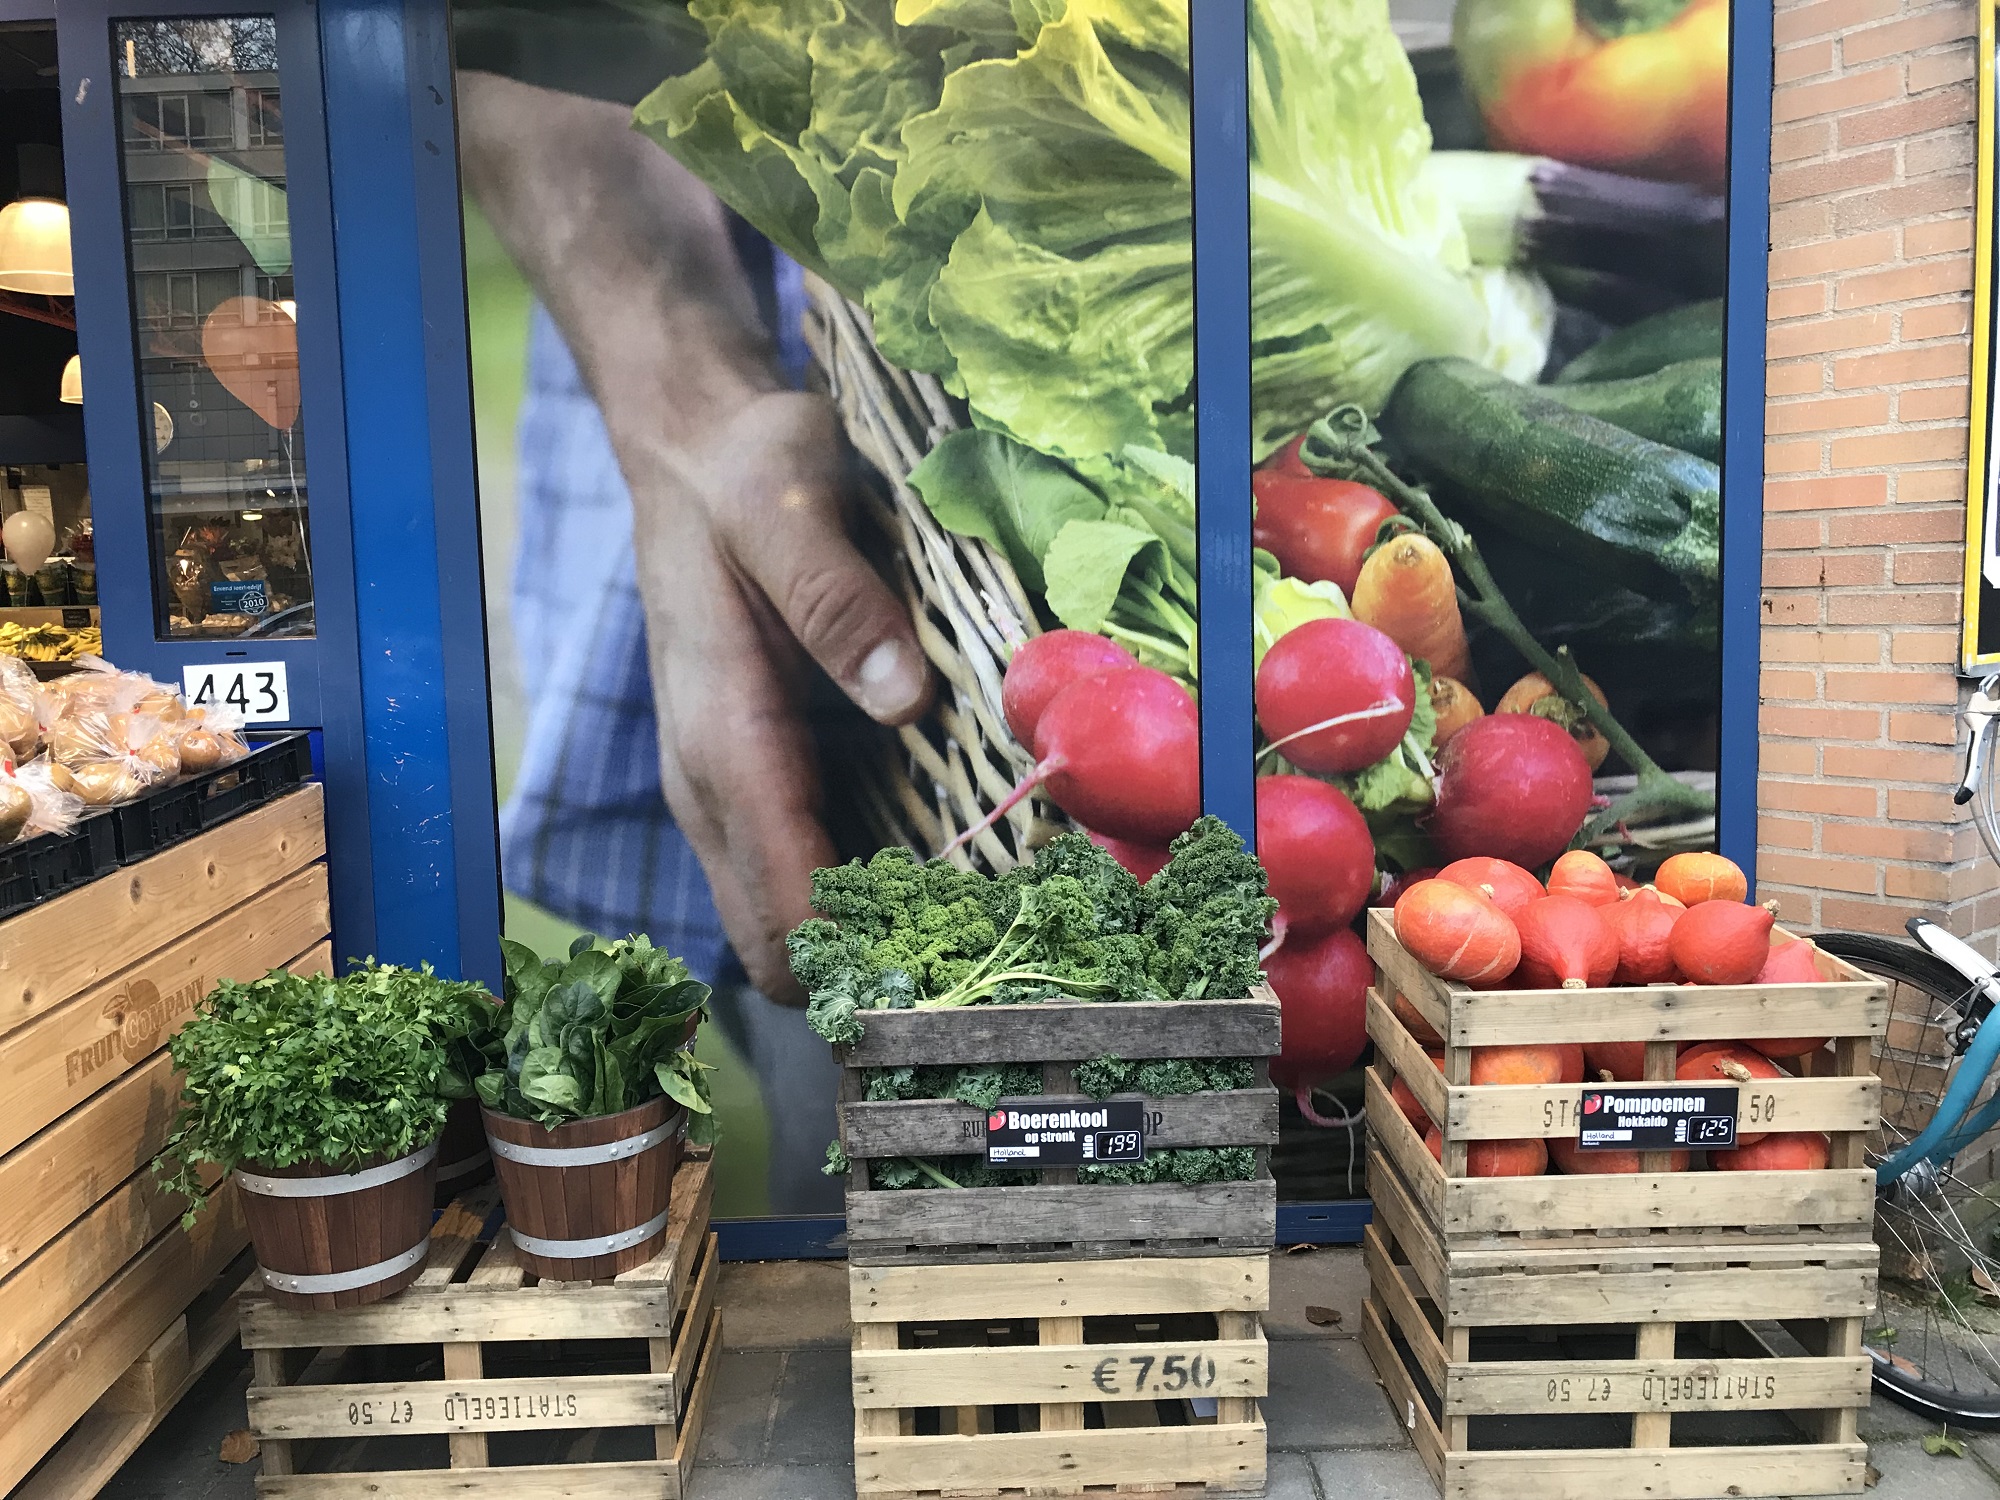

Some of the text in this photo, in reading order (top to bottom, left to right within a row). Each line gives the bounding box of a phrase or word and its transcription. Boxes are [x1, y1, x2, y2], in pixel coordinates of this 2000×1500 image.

[243, 598, 264, 609] 2010
[193, 672, 278, 714] 443
[1603, 1095, 1706, 1114] Pompoenen
[1008, 1109, 1108, 1130] Boerenkool
[1618, 1116, 1668, 1128] Hokkaido
[1700, 1118, 1729, 1140] 125
[1025, 1130, 1076, 1144] op stronk
[1108, 1133, 1137, 1155] 199
[1586, 1131, 1615, 1140] Holland
[1642, 1375, 1776, 1401] STATIEGELD
[444, 1394, 577, 1421] STATIEGELD
